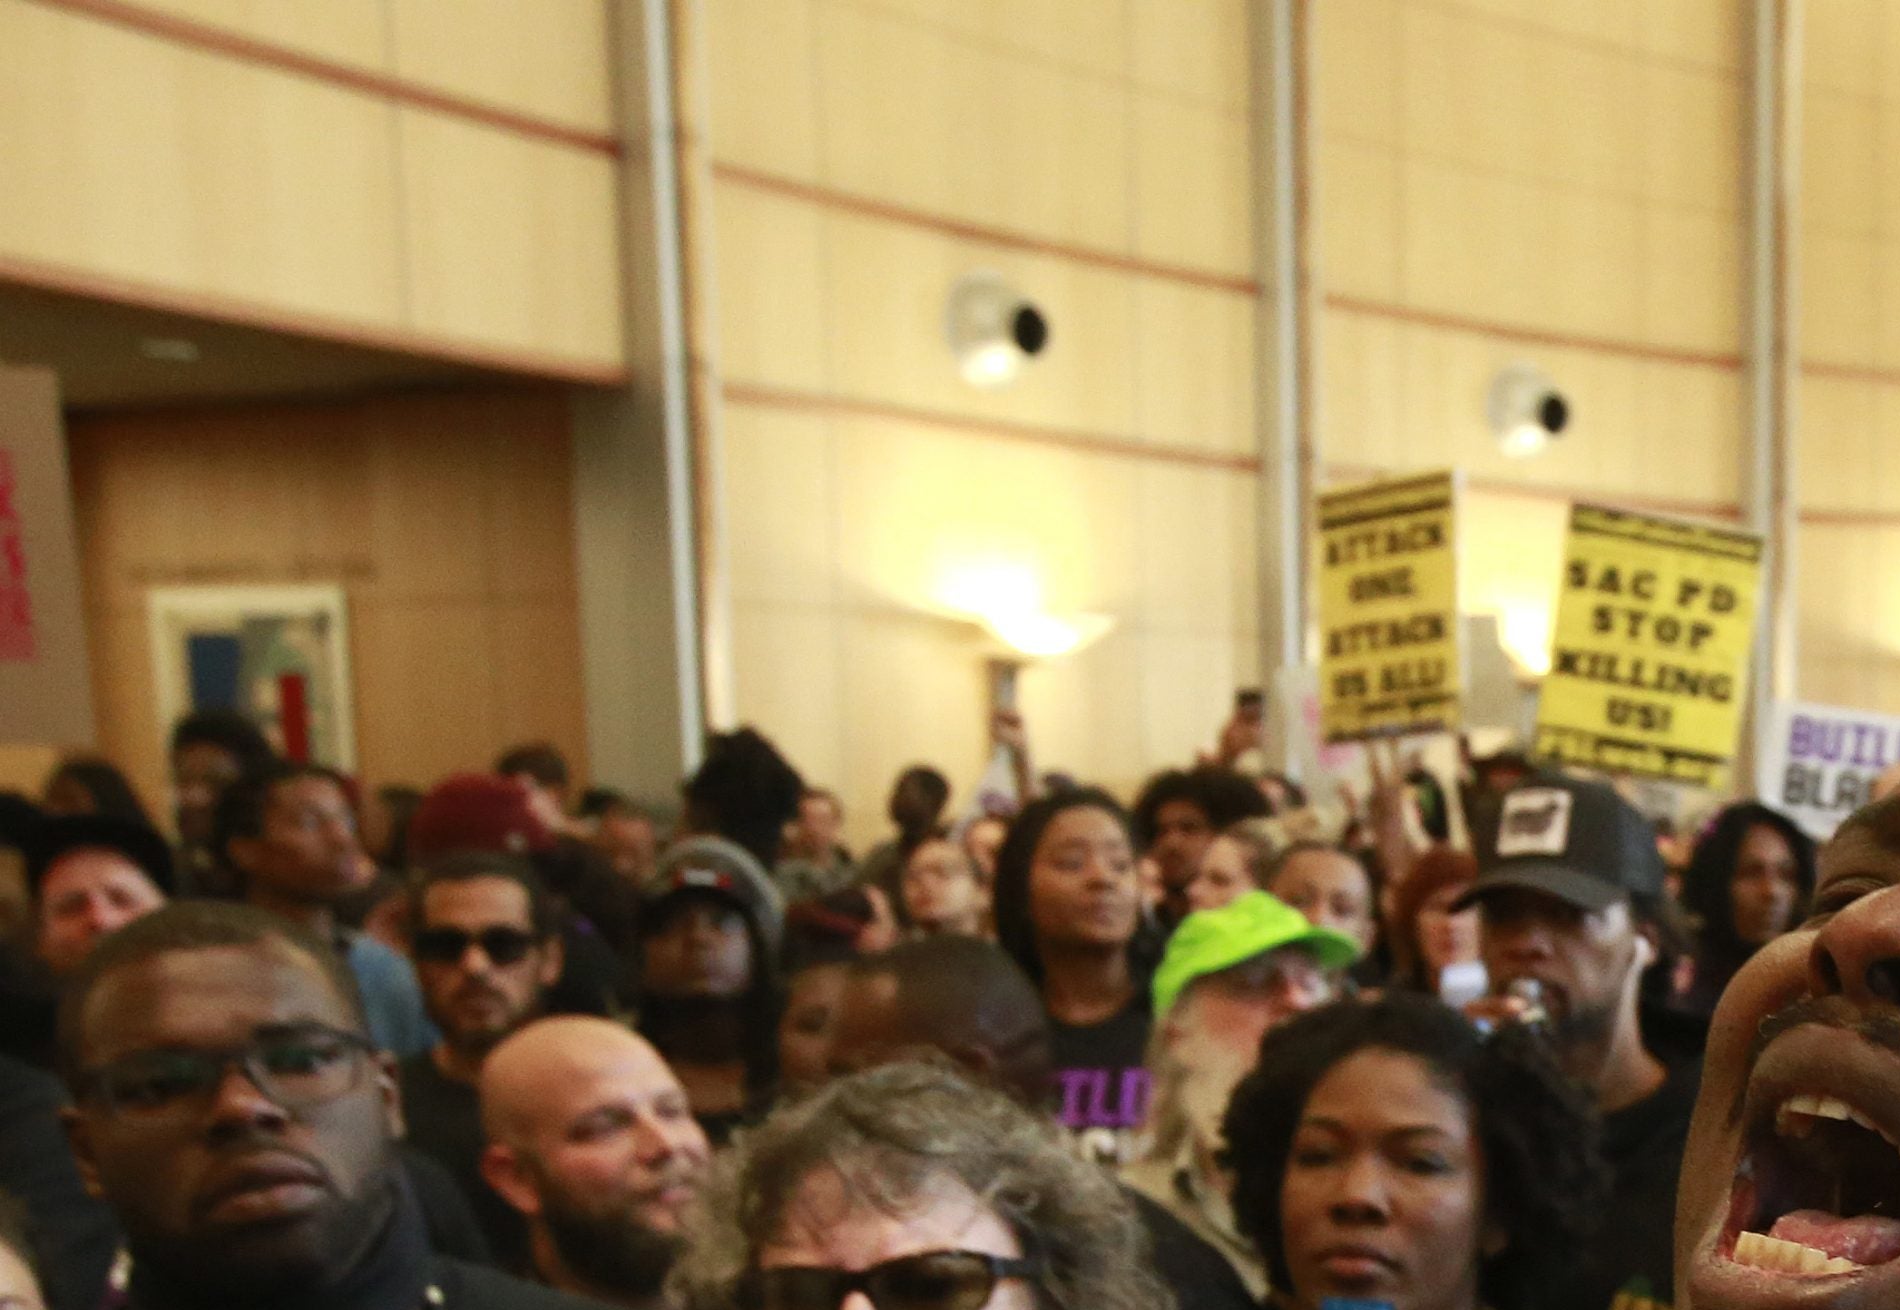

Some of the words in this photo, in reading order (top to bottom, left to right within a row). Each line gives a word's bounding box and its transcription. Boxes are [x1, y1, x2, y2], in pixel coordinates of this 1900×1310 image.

[1325, 521, 1444, 567] ATTACK
[1350, 564, 1413, 603] ONE
[1567, 558, 1657, 601] SAC
[1675, 577, 1737, 614] PD
[1327, 612, 1444, 658] ATTACK
[1593, 603, 1714, 649] STOP
[1333, 667, 1368, 698] US
[1555, 648, 1734, 704] KILLING
[1605, 695, 1673, 732] US!
[1783, 761, 1872, 811] BLA
